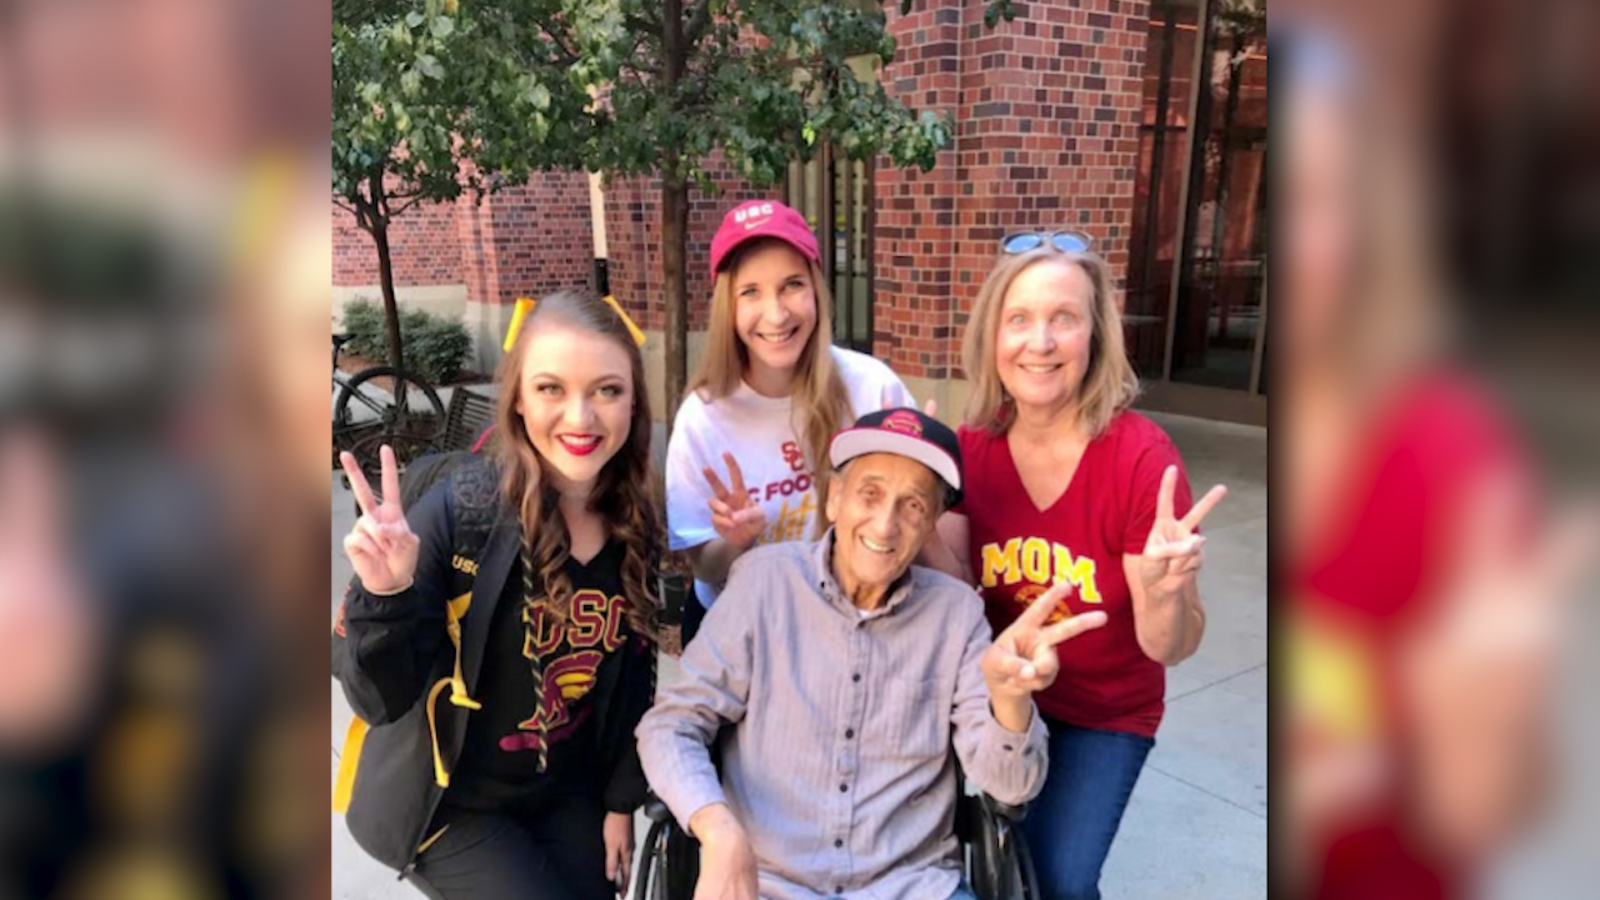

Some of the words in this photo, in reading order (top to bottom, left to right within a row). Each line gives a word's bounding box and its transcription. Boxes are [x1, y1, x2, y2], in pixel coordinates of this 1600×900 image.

[734, 203, 773, 223] USC
[766, 473, 815, 501] FOO
[981, 536, 1103, 603] MOM
[522, 589, 629, 660] USC
